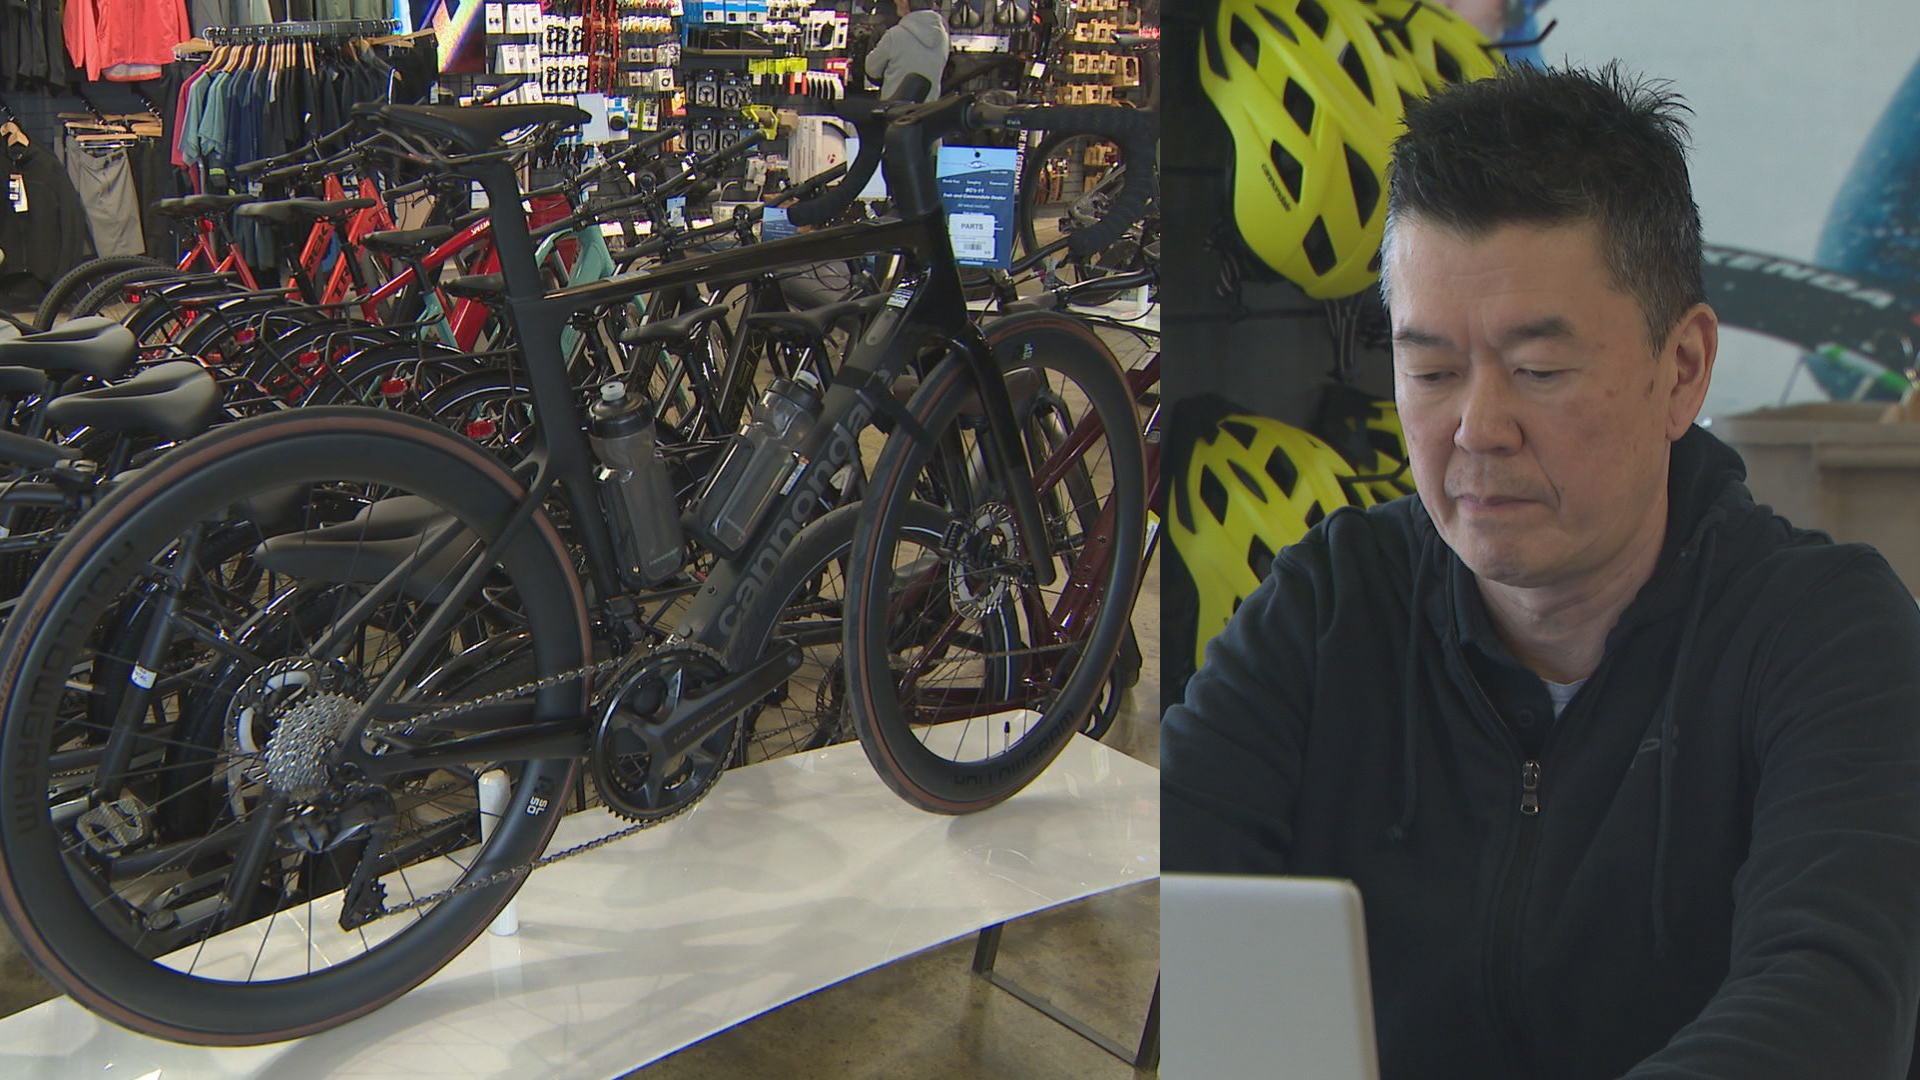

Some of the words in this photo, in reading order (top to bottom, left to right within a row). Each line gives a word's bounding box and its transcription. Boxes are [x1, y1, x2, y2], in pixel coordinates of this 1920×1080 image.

[1018, 130, 1028, 142] DE
[1261, 162, 1291, 212] cannondale
[470, 220, 491, 237] SPECIA
[960, 223, 984, 231] PARTS
[718, 368, 895, 636] cannondale
